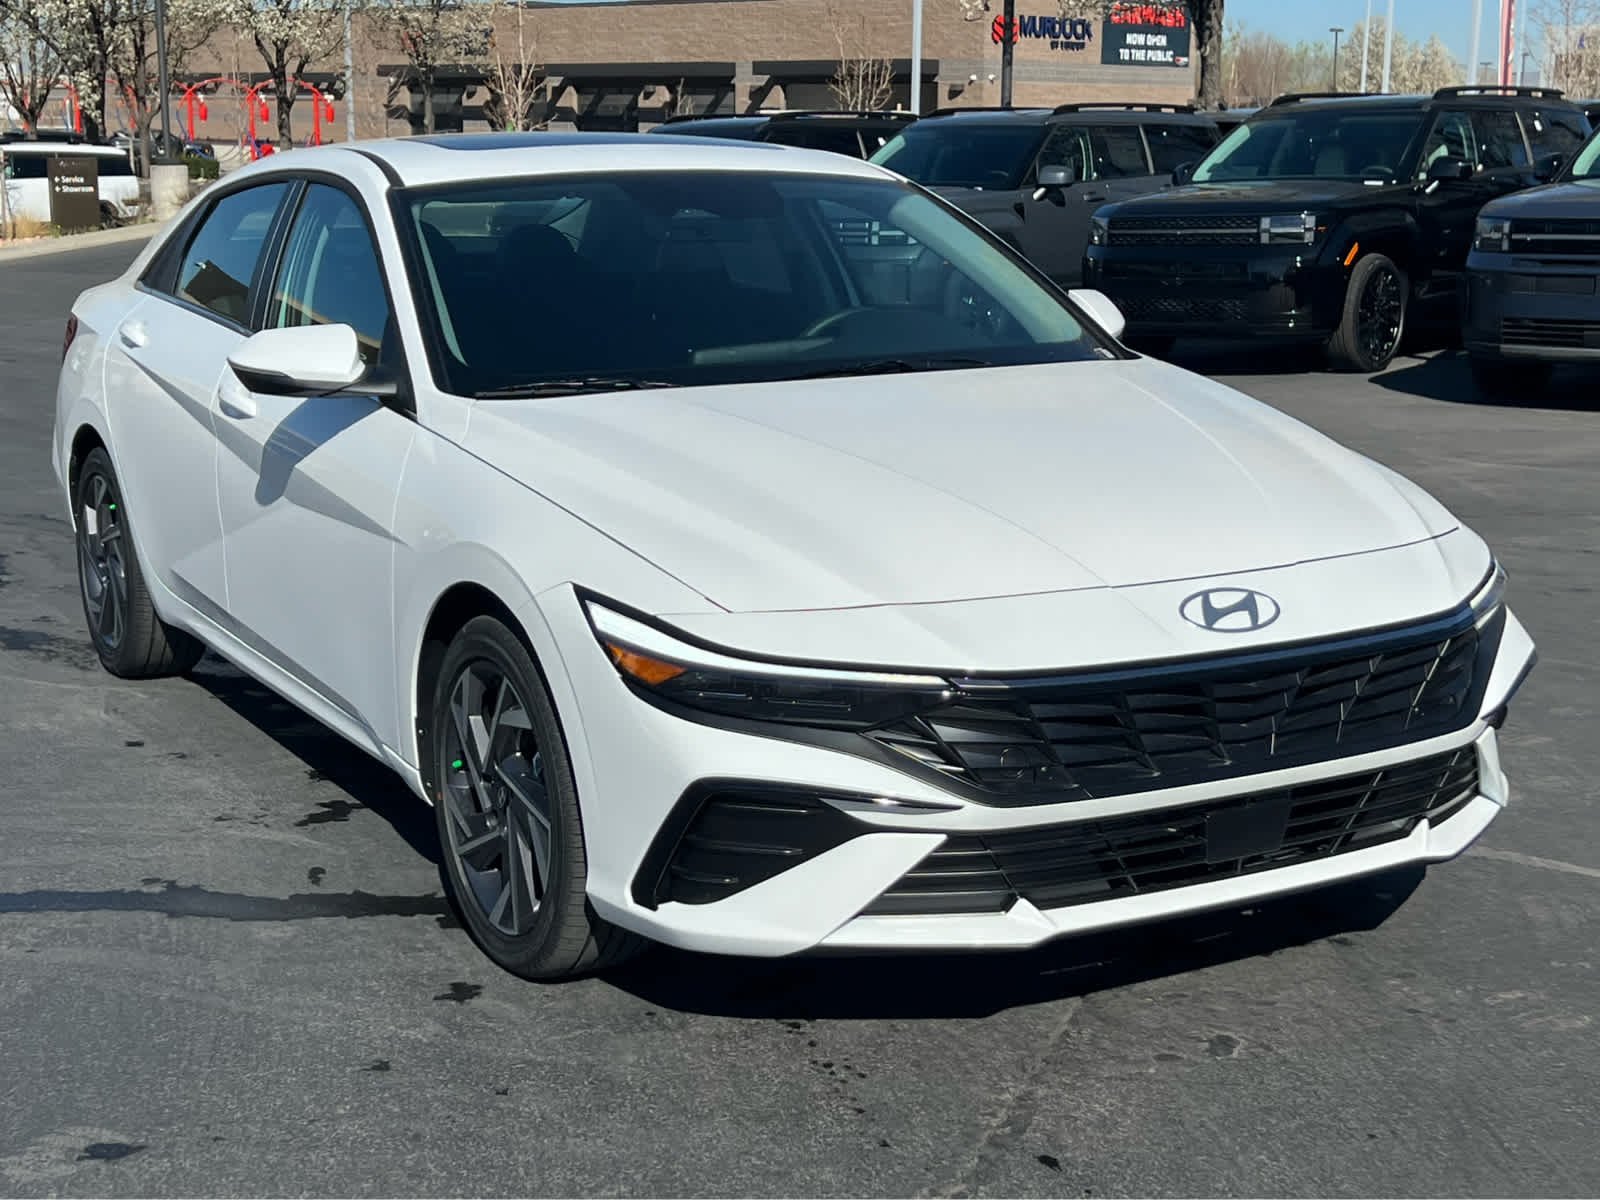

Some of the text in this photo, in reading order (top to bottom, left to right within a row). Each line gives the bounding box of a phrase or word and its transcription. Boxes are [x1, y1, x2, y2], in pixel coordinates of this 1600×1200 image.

[1019, 15, 1092, 41] MURDOCK
[1126, 33, 1167, 46] NOW OPEN
[1119, 48, 1129, 60] TO
[1131, 49, 1145, 60] THE
[1147, 50, 1174, 62] PUBLIC
